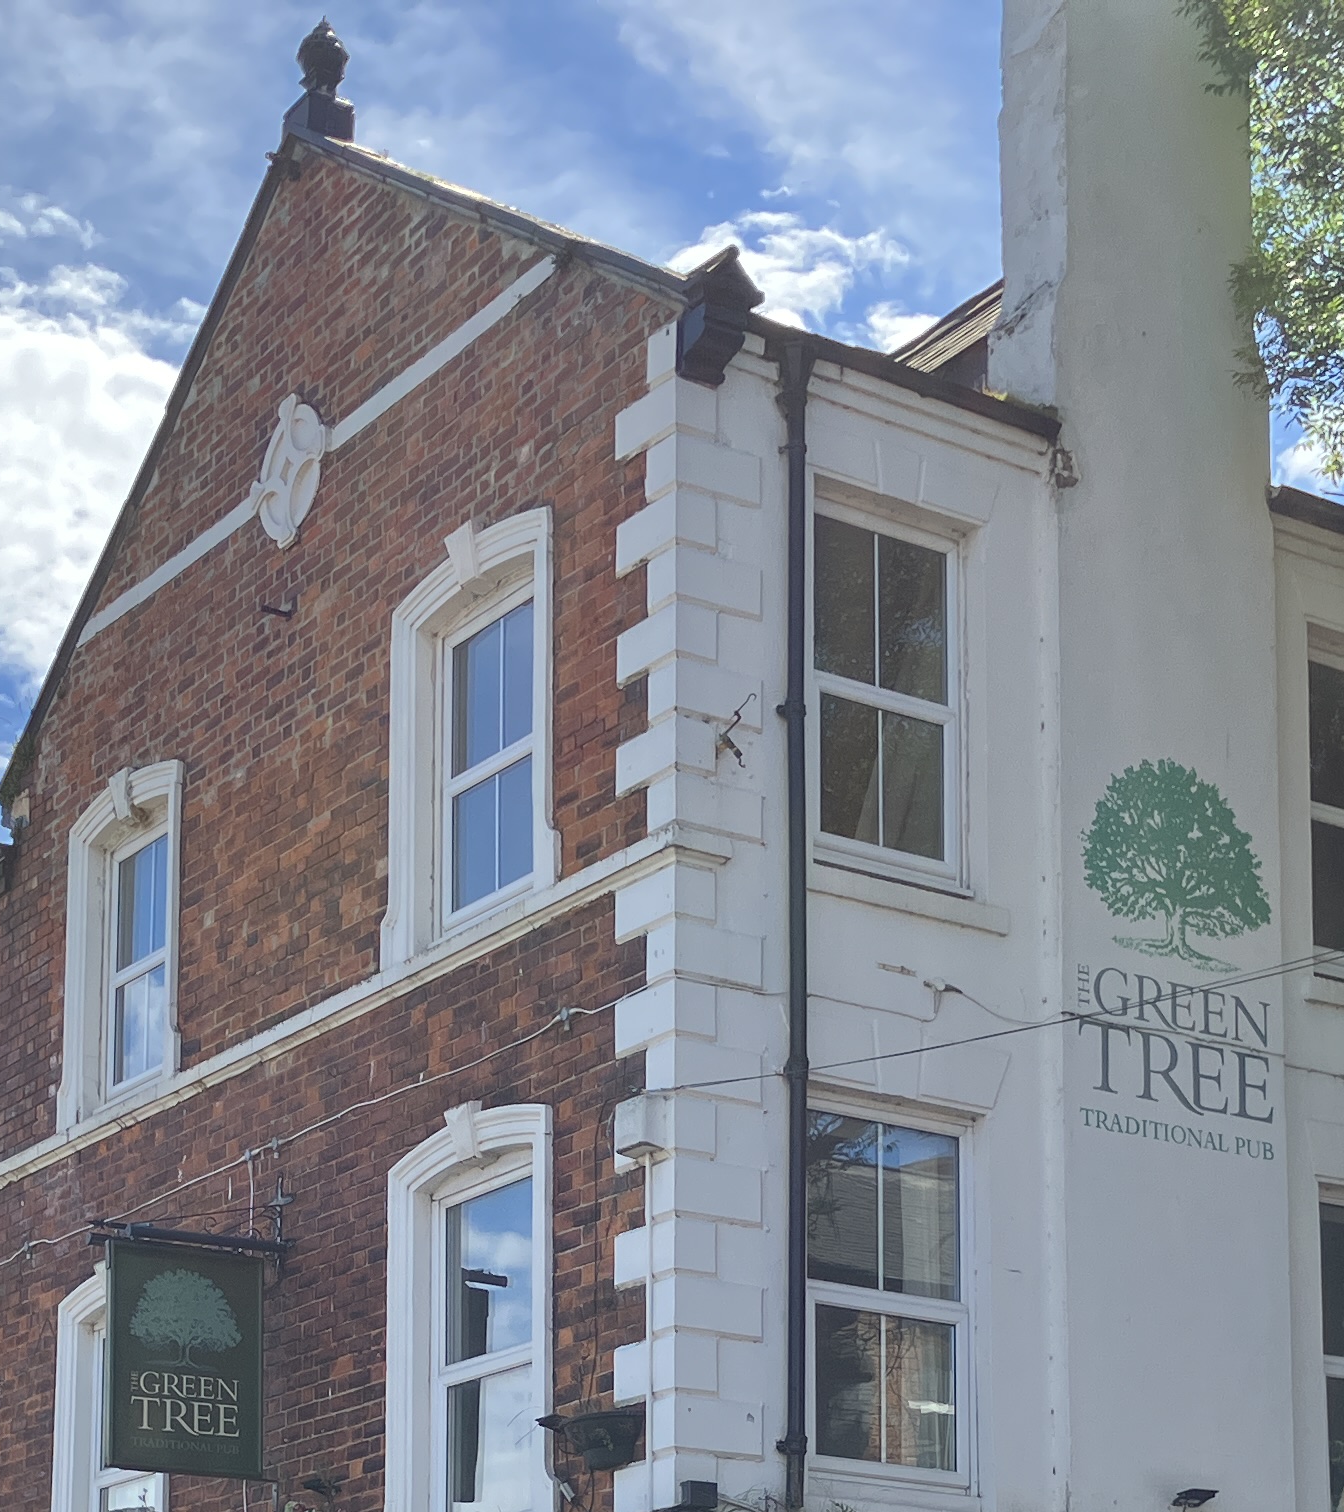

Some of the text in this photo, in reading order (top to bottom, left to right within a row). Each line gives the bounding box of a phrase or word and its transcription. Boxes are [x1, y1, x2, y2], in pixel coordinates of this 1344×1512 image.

[1077, 963, 1090, 1008] THE
[1093, 967, 1271, 1048] GREEN
[1078, 1016, 1274, 1124] TREE
[1079, 1106, 1275, 1161] TRADITIONAL PUB
[130, 1370, 139, 1391] THE
[139, 1371, 240, 1402] GREEN
[130, 1395, 240, 1438] TREE
[131, 1436, 212, 1453] TRADITIONAL
